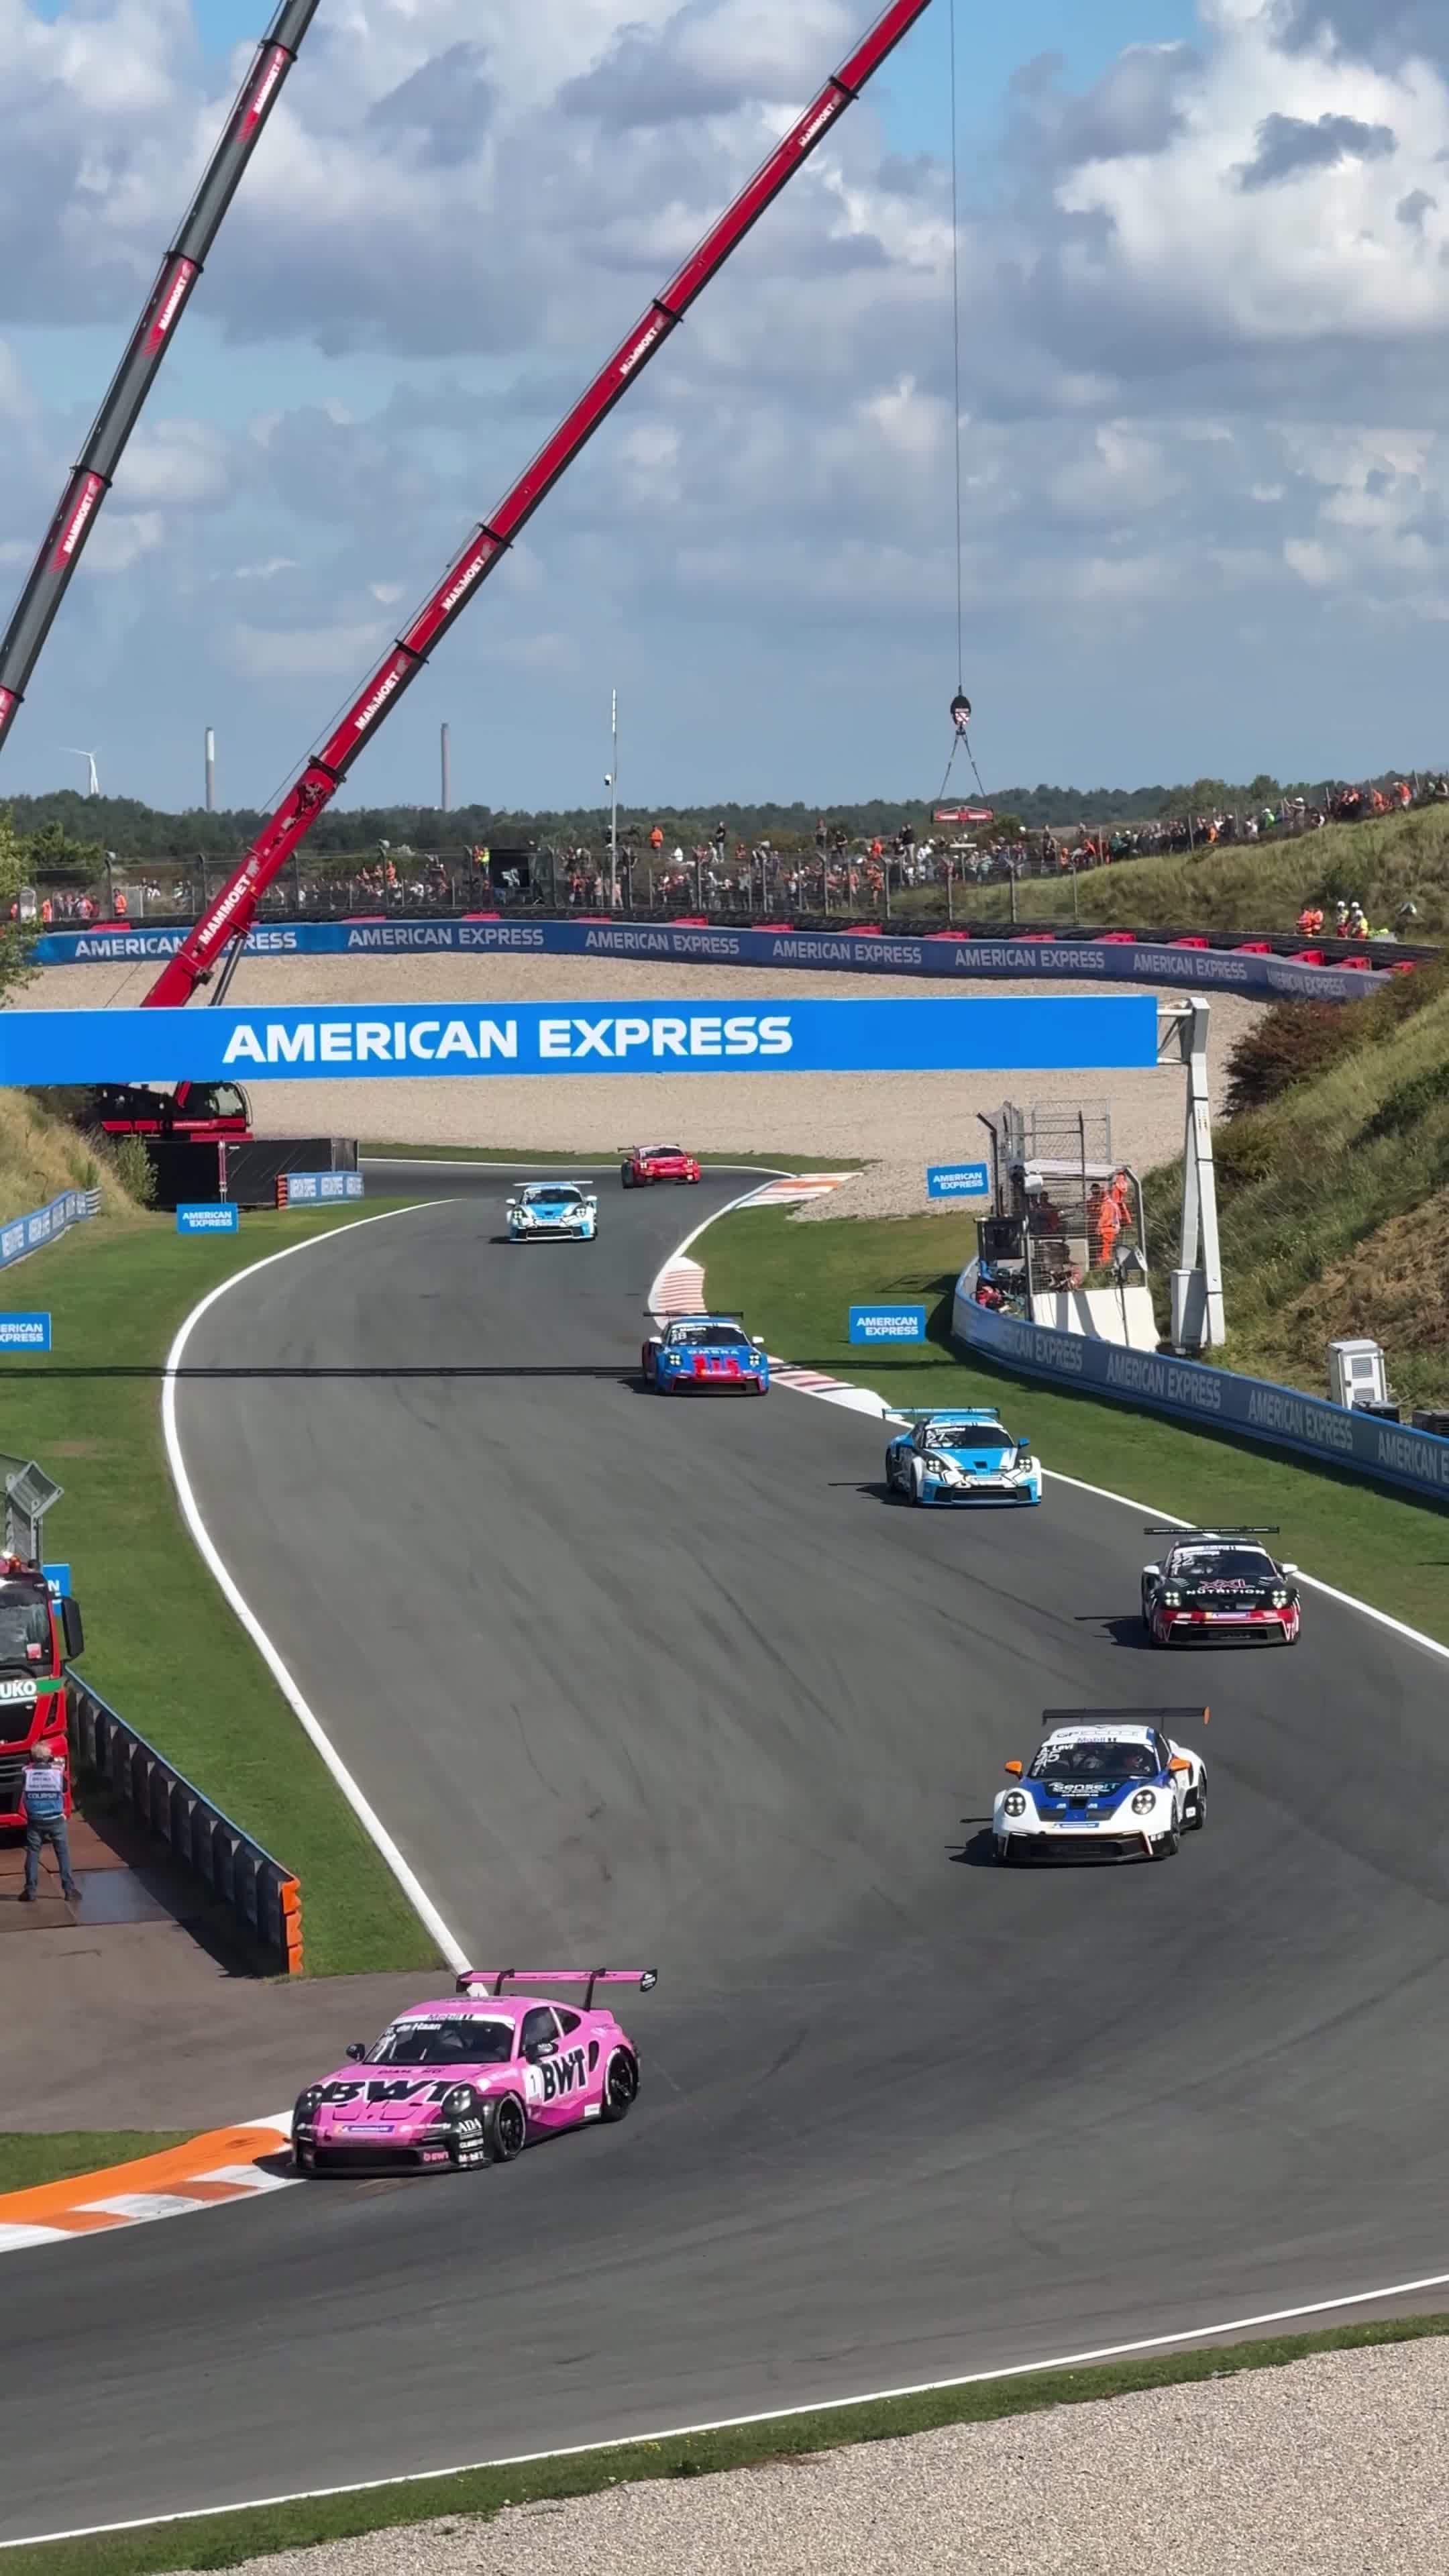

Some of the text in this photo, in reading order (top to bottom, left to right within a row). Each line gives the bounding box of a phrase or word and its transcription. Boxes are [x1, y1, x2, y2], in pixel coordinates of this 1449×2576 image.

[158, 276, 187, 330] MAMMOET
[63, 493, 94, 553] MAMMOET
[199, 874, 251, 945] MAMMOET
[348, 928, 545, 947] AMERICAN EXPRESS
[585, 930, 740, 955] AMERICAN EXPRESS
[772, 940, 922, 964] AMERICAN EXPRESS
[955, 949, 1106, 969] AMERICAN EXPRESS
[1132, 953, 1248, 981] AMERICAN EXPRESS
[223, 1017, 792, 1063] AMERICAN EXPRESS
[933, 1172, 983, 1183] AMERICAN
[940, 1179, 984, 1190] EXPRESS
[182, 1211, 232, 1220] AMERICAN
[189, 1218, 233, 1228] EXPRESS
[856, 1316, 918, 1327] AMERICAN
[865, 1326, 918, 1336] EXPRESS
[1107, 1352, 1222, 1409] AMERICAN EXPRESS
[1247, 1389, 1353, 1450] AMERICAN EXPRESS
[1378, 1430, 1438, 1481] AMERICAN
[412, 2023, 443, 2031] Haan
[543, 2048, 586, 2102] BWT
